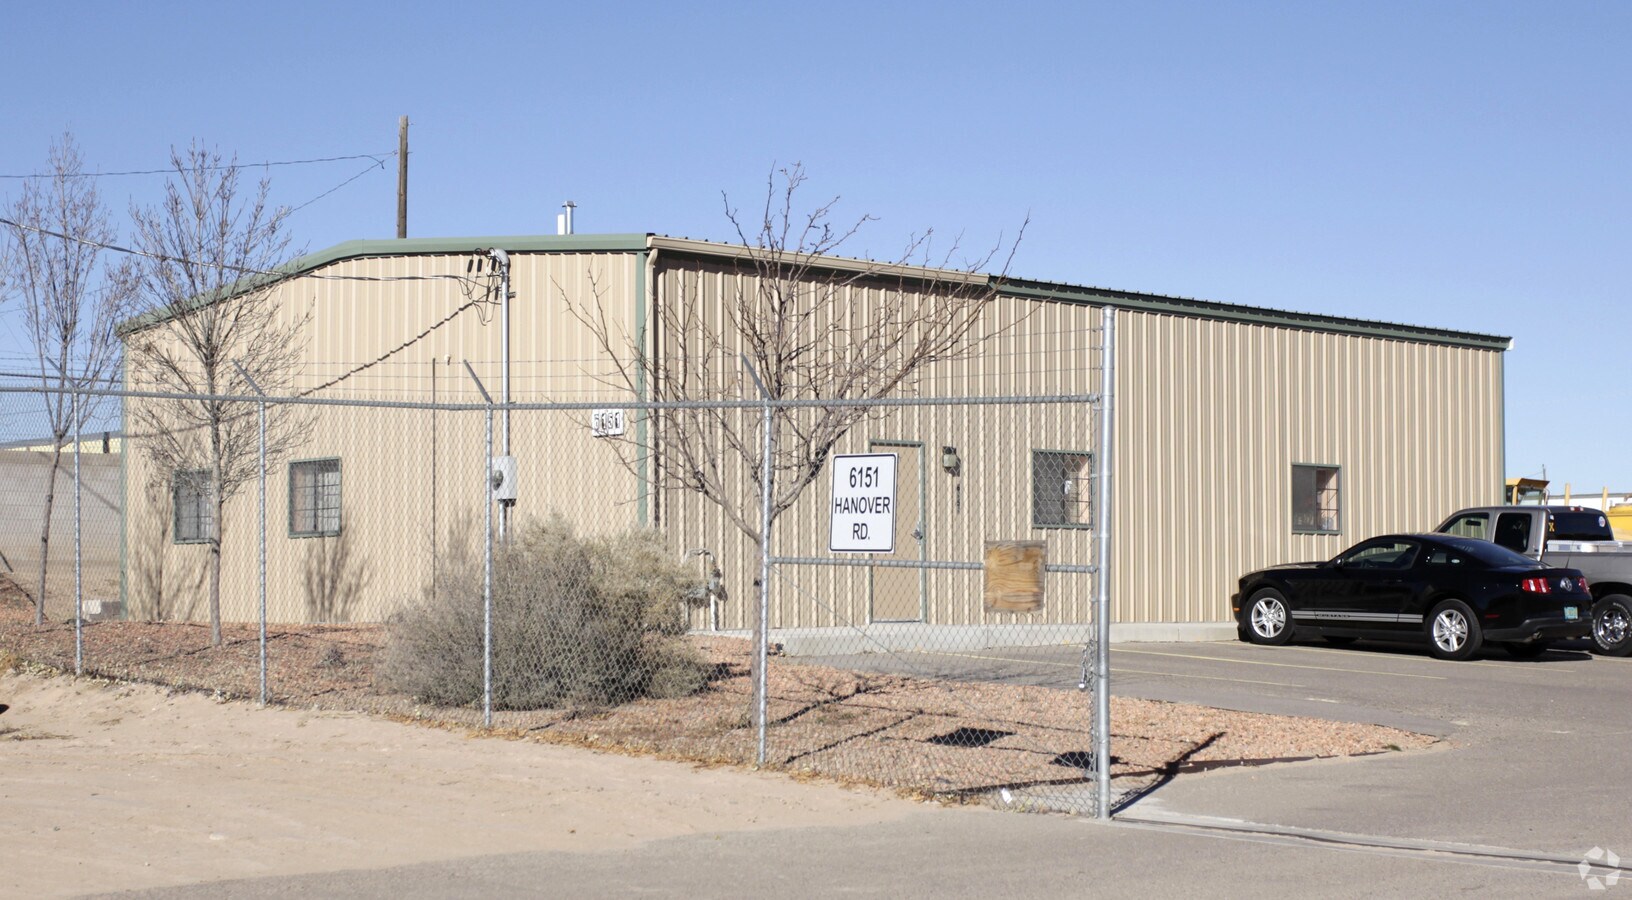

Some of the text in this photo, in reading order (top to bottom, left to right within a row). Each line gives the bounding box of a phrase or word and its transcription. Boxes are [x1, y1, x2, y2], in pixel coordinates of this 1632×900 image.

[849, 466, 879, 488] 6151
[834, 496, 891, 514] HANOVER
[852, 522, 871, 540] RD.
